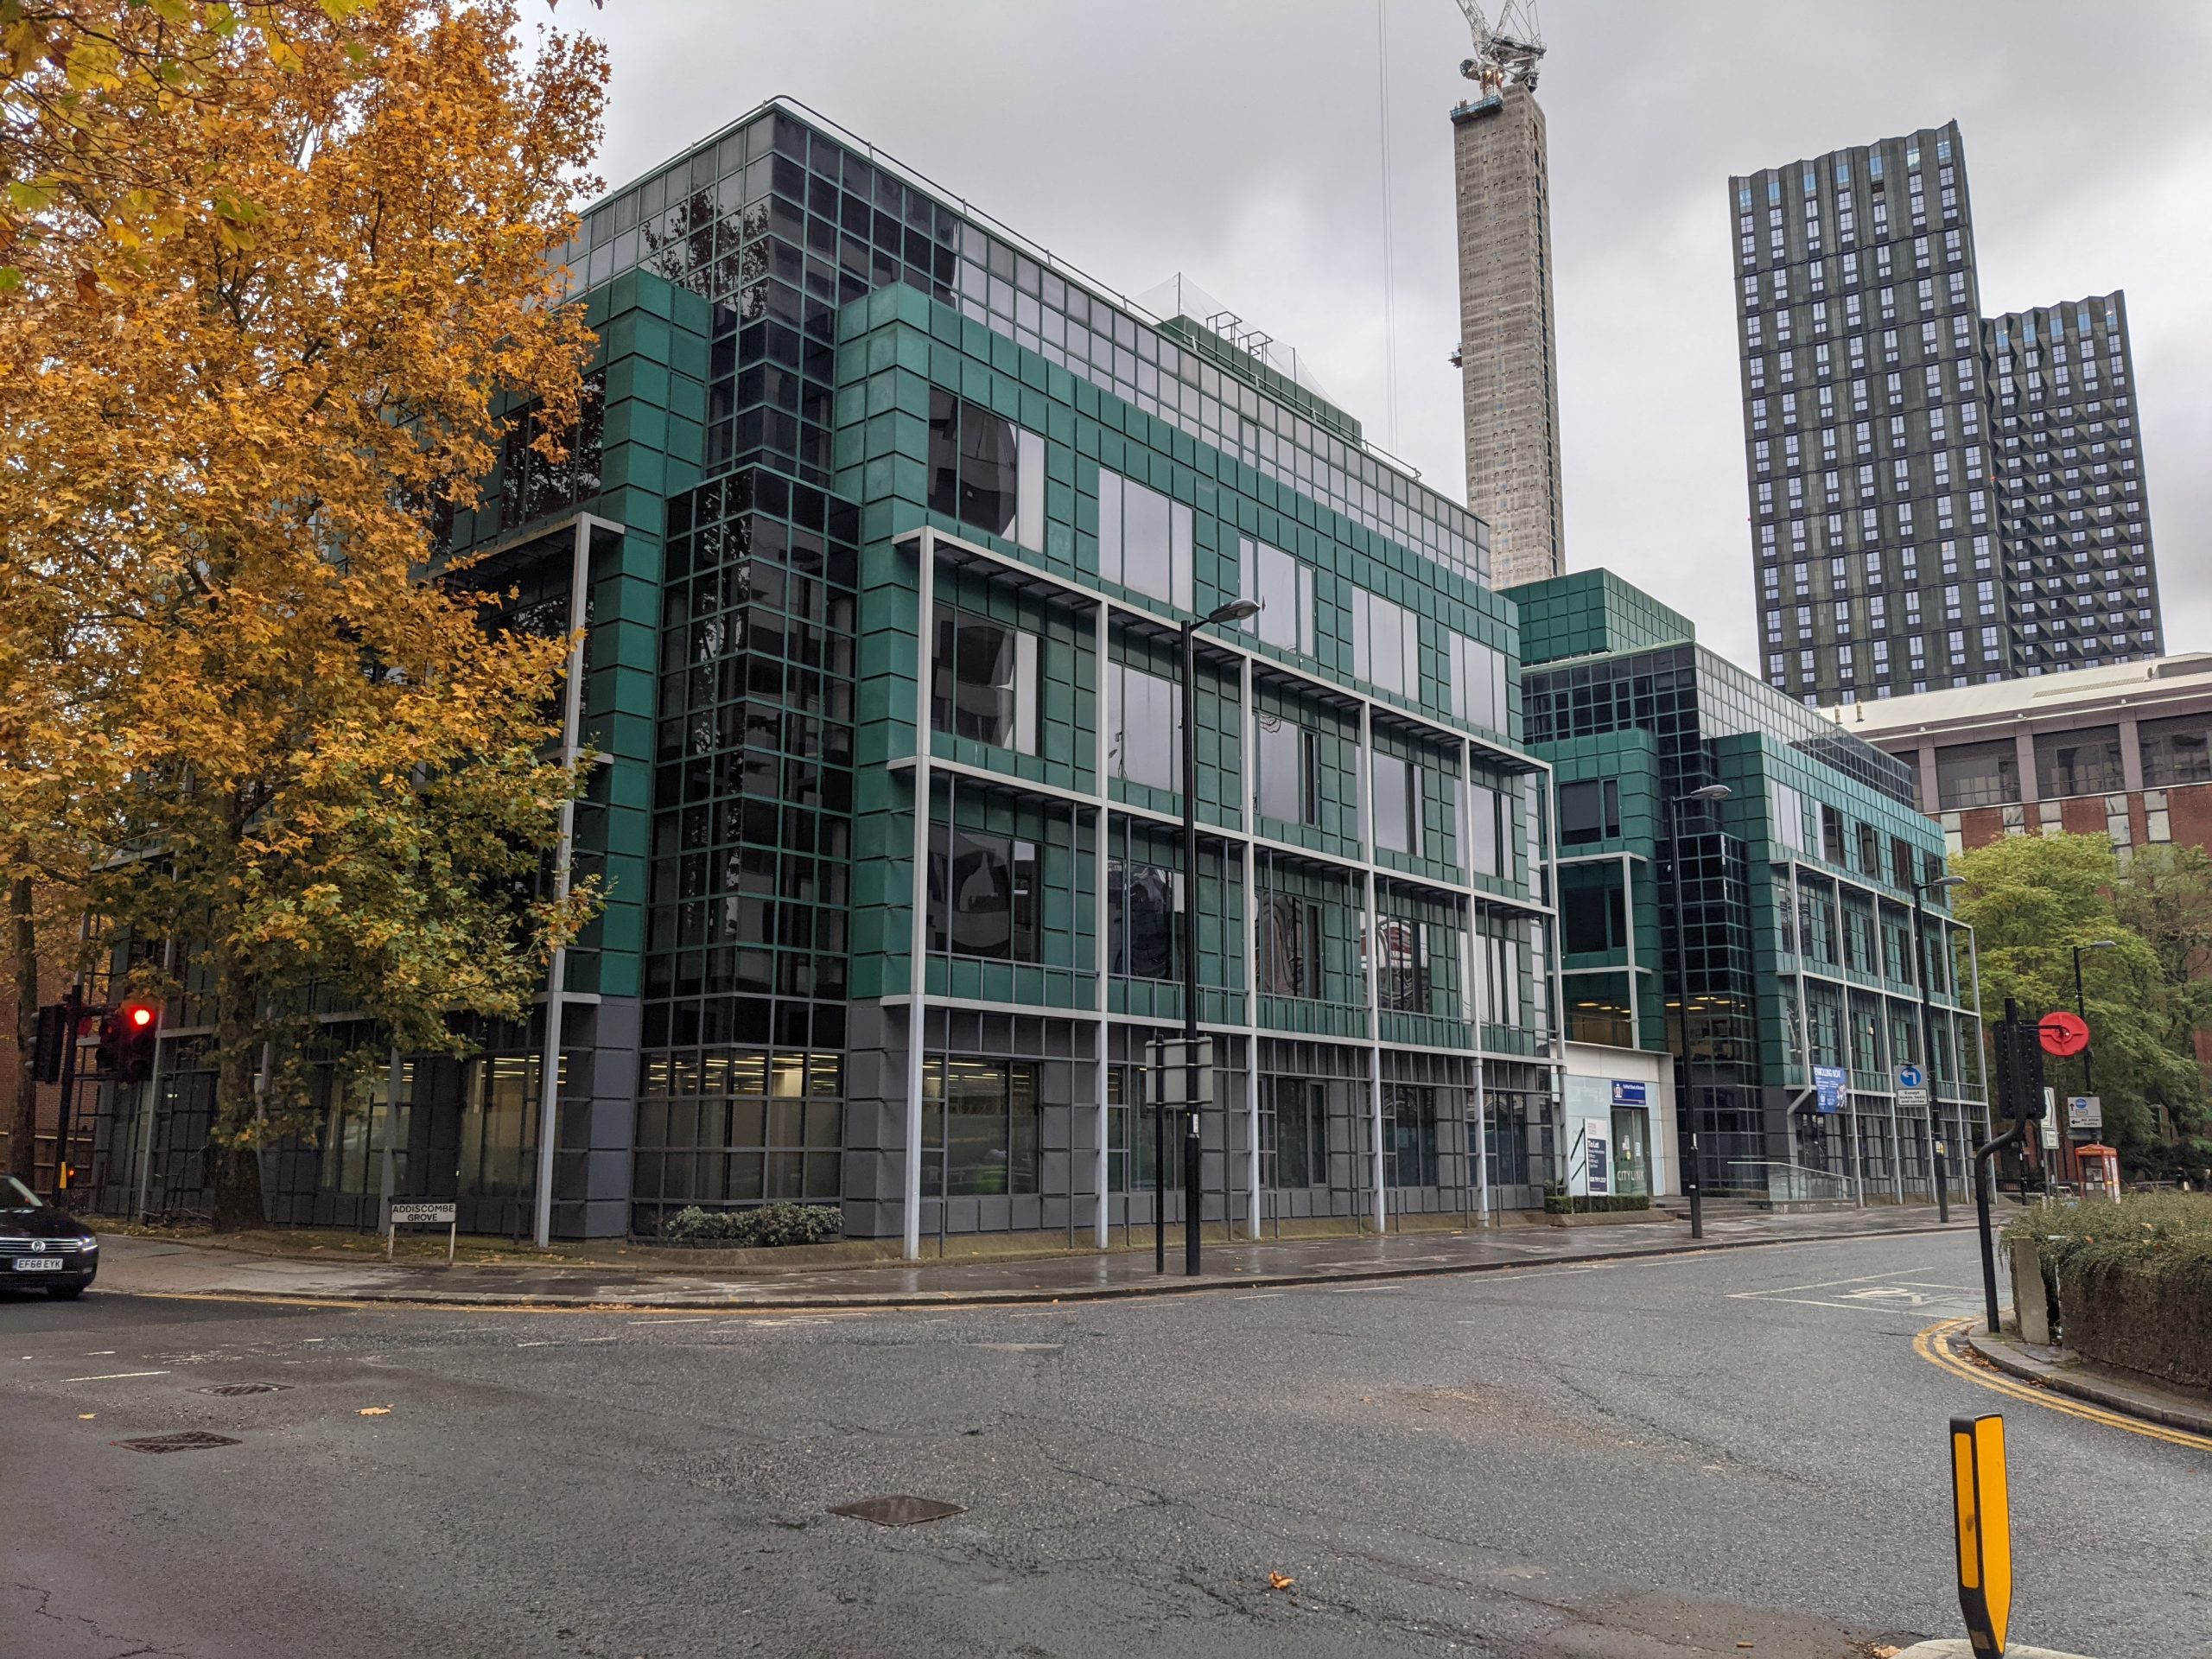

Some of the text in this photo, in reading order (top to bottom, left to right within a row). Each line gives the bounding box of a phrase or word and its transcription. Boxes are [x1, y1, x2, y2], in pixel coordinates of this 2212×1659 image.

[392, 1205, 454, 1213] ADDISCOMBE
[18, 1260, 61, 1268] EF68 EYK
